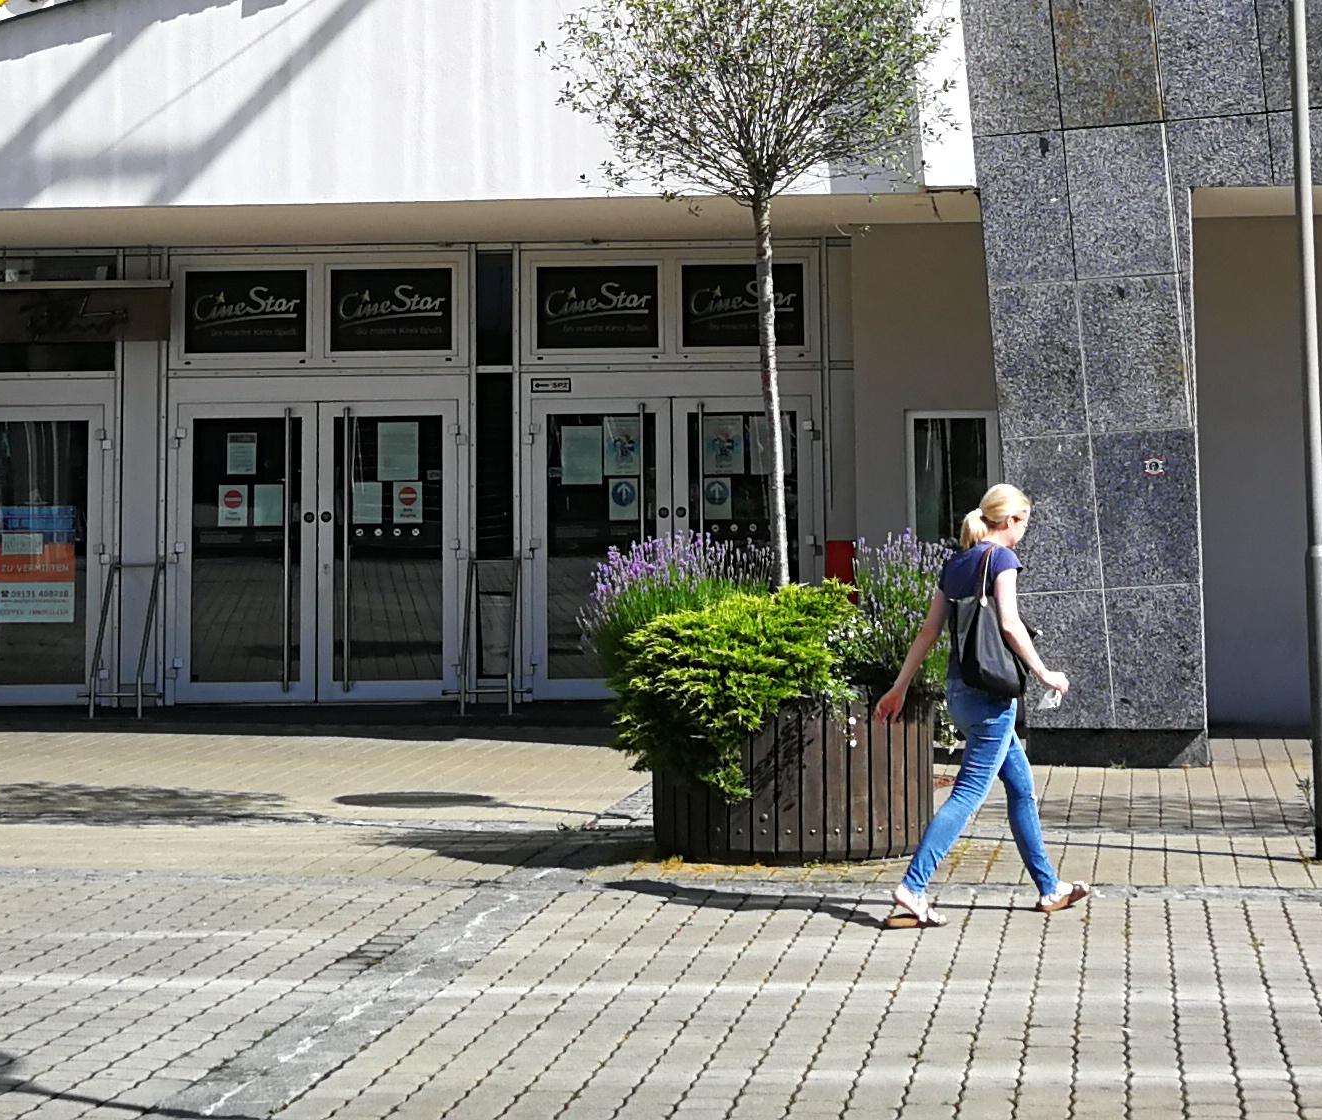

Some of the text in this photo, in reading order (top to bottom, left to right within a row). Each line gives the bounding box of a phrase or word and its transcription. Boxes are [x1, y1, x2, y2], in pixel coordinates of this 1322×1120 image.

[194, 286, 301, 322] CineStar
[339, 284, 446, 321] CineStar
[545, 282, 652, 317] CineStar
[690, 280, 797, 317] CineSar
